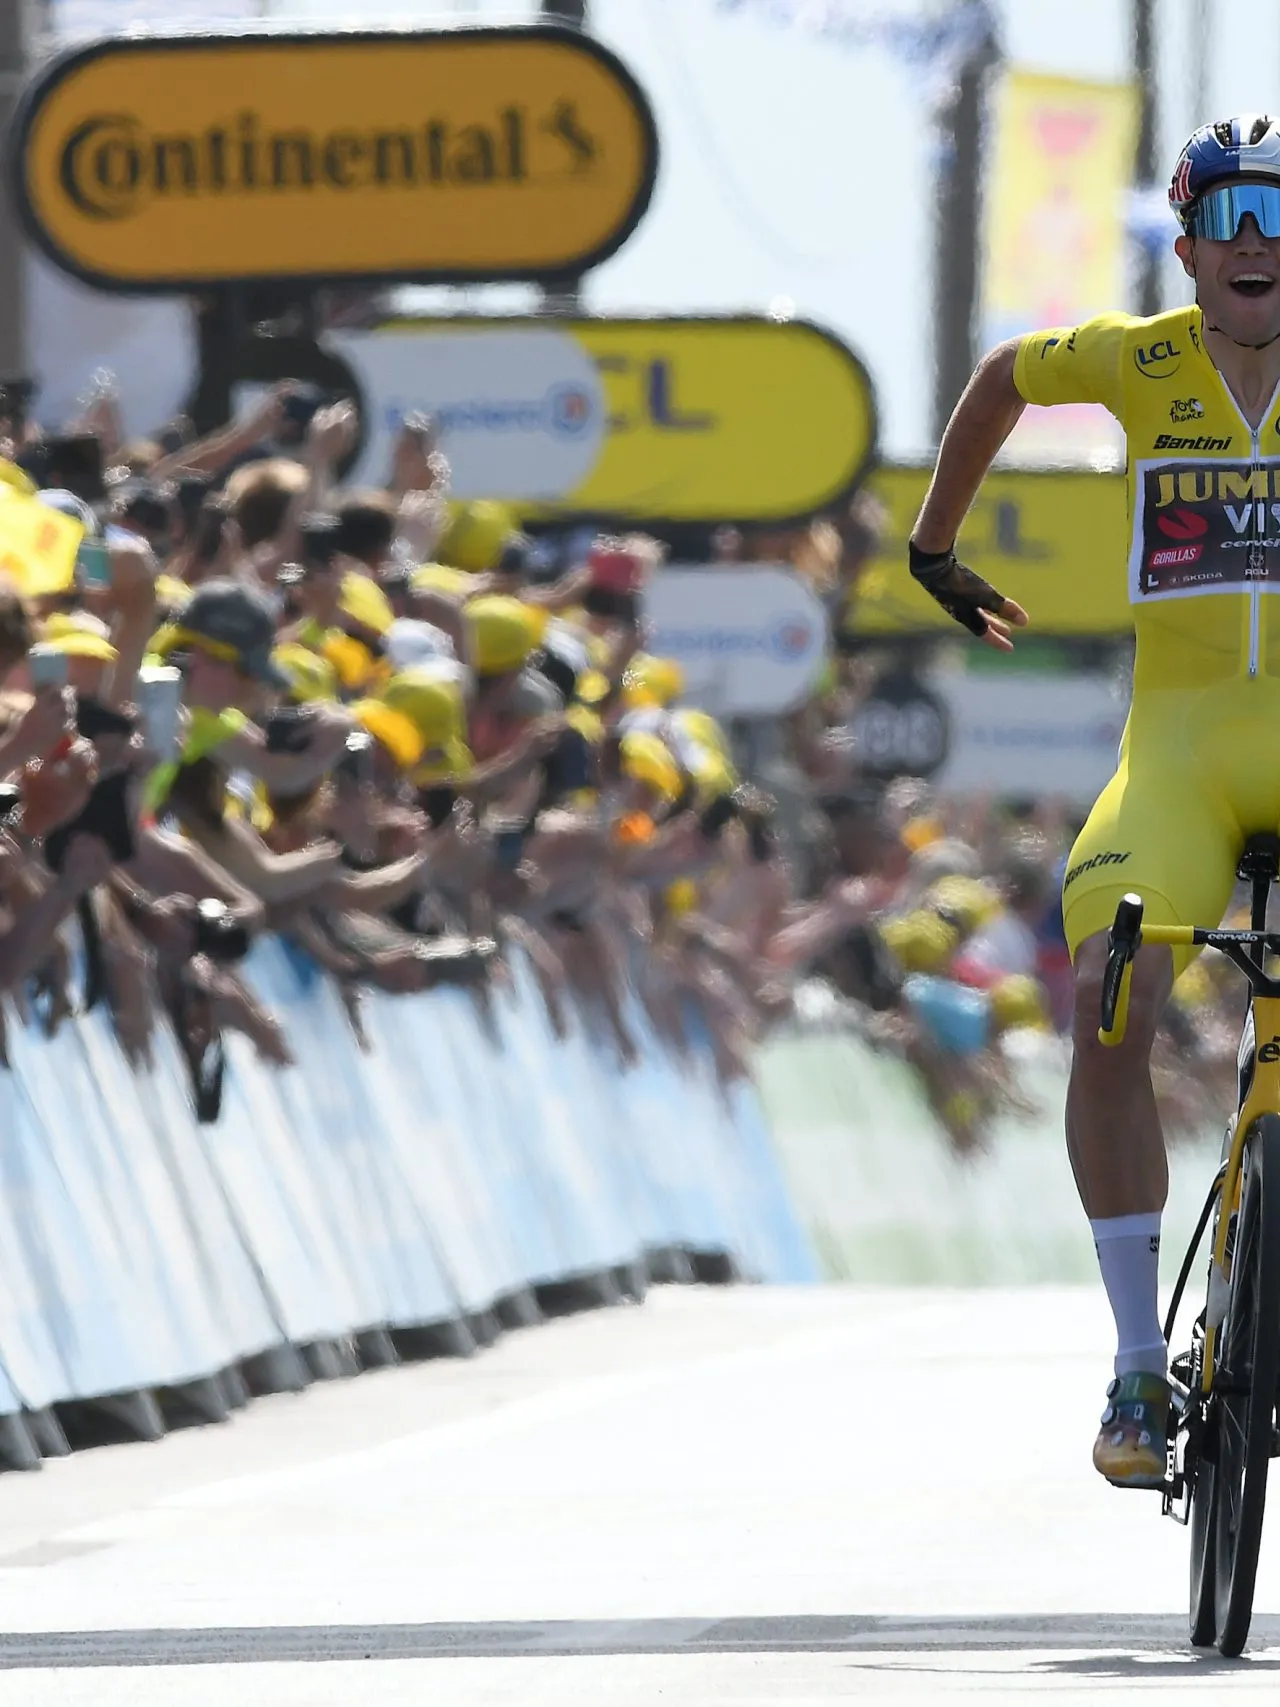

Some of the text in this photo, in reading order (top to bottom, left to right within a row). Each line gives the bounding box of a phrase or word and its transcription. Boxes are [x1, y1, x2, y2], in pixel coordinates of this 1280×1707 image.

[60, 107, 528, 220] Continental
[1138, 340, 1181, 365] LCL
[1153, 434, 1233, 450] Santini
[1153, 548, 1196, 565] GORILLAS
